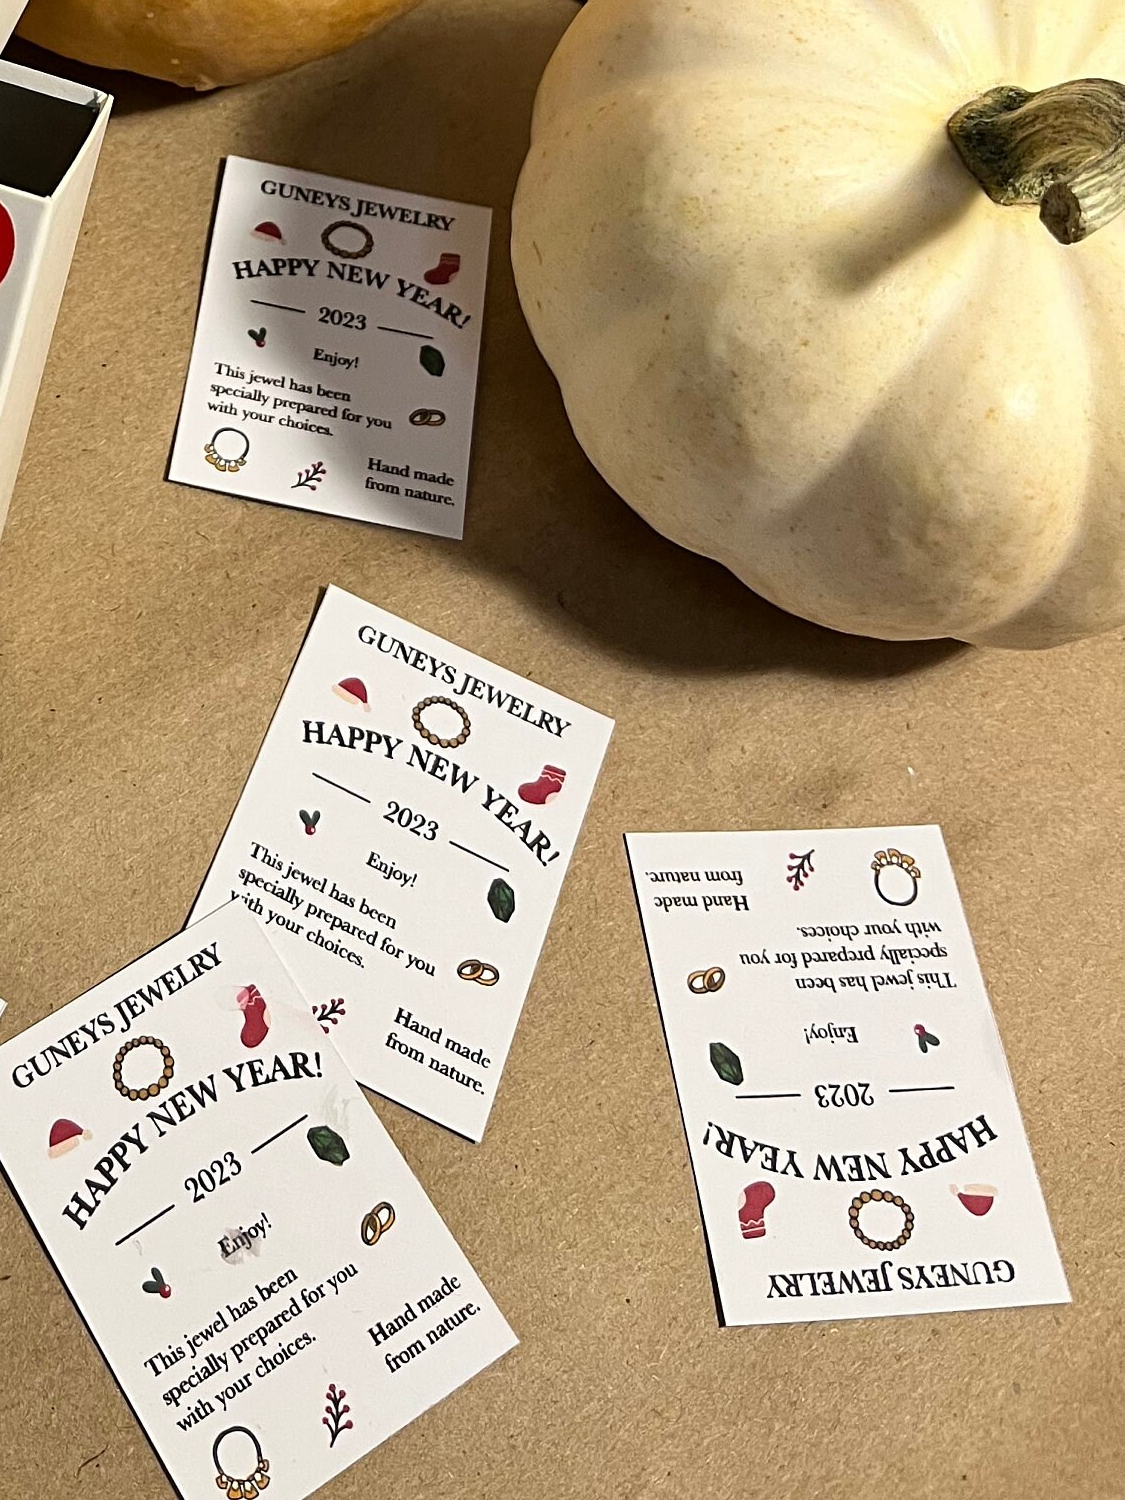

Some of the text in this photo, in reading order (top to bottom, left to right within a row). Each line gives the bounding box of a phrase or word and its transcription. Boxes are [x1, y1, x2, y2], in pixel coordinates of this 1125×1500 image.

[259, 180, 455, 231] GUNEYS JEWELRY
[230, 258, 470, 329] HAPPY NEW YEAR!
[317, 306, 366, 330] 2023
[213, 362, 350, 402] This jewel has been
[312, 347, 358, 370] Enjoy!
[206, 400, 333, 436] with your choices.
[209, 383, 391, 429] specially prepared for you
[364, 476, 454, 506] from nature.
[367, 457, 453, 486] Hand made
[357, 625, 572, 738] GUNEYS JEWELRY
[301, 720, 560, 867] HAPPY NEW YEAR!
[382, 800, 439, 841] 2023
[250, 841, 396, 929] This jewel has been
[365, 850, 417, 888] Enjoy!
[644, 869, 743, 885] from nature.
[238, 868, 435, 976] specially prepared for you
[653, 893, 750, 912] Hand made
[265, 909, 304, 935] your
[306, 928, 364, 968] choices.
[795, 918, 941, 942] with your choices.
[738, 941, 947, 968] specially prepared for you
[794, 968, 956, 993] This jewel has been
[12, 941, 222, 1089] GUNEYS JEWELRY
[393, 1007, 490, 1068] Hand made
[803, 1021, 858, 1044] Enjoy!
[384, 1032, 483, 1094] from nature.
[814, 1081, 874, 1108] 2023
[61, 1039, 322, 1230] HAPPY NEW YEAR!
[702, 1114, 998, 1183] HAPPY NEW YEAR!
[183, 1151, 242, 1203] 2023
[217, 1212, 272, 1257] Enjoy!
[766, 1259, 1014, 1298] GUNEYS JEWELRY
[143, 1269, 298, 1376] This jewel has been
[162, 1263, 358, 1408] specially prepared for you
[367, 1276, 460, 1347] Hand made
[384, 1303, 480, 1373] from nature.
[176, 1332, 316, 1431] with your choices.
